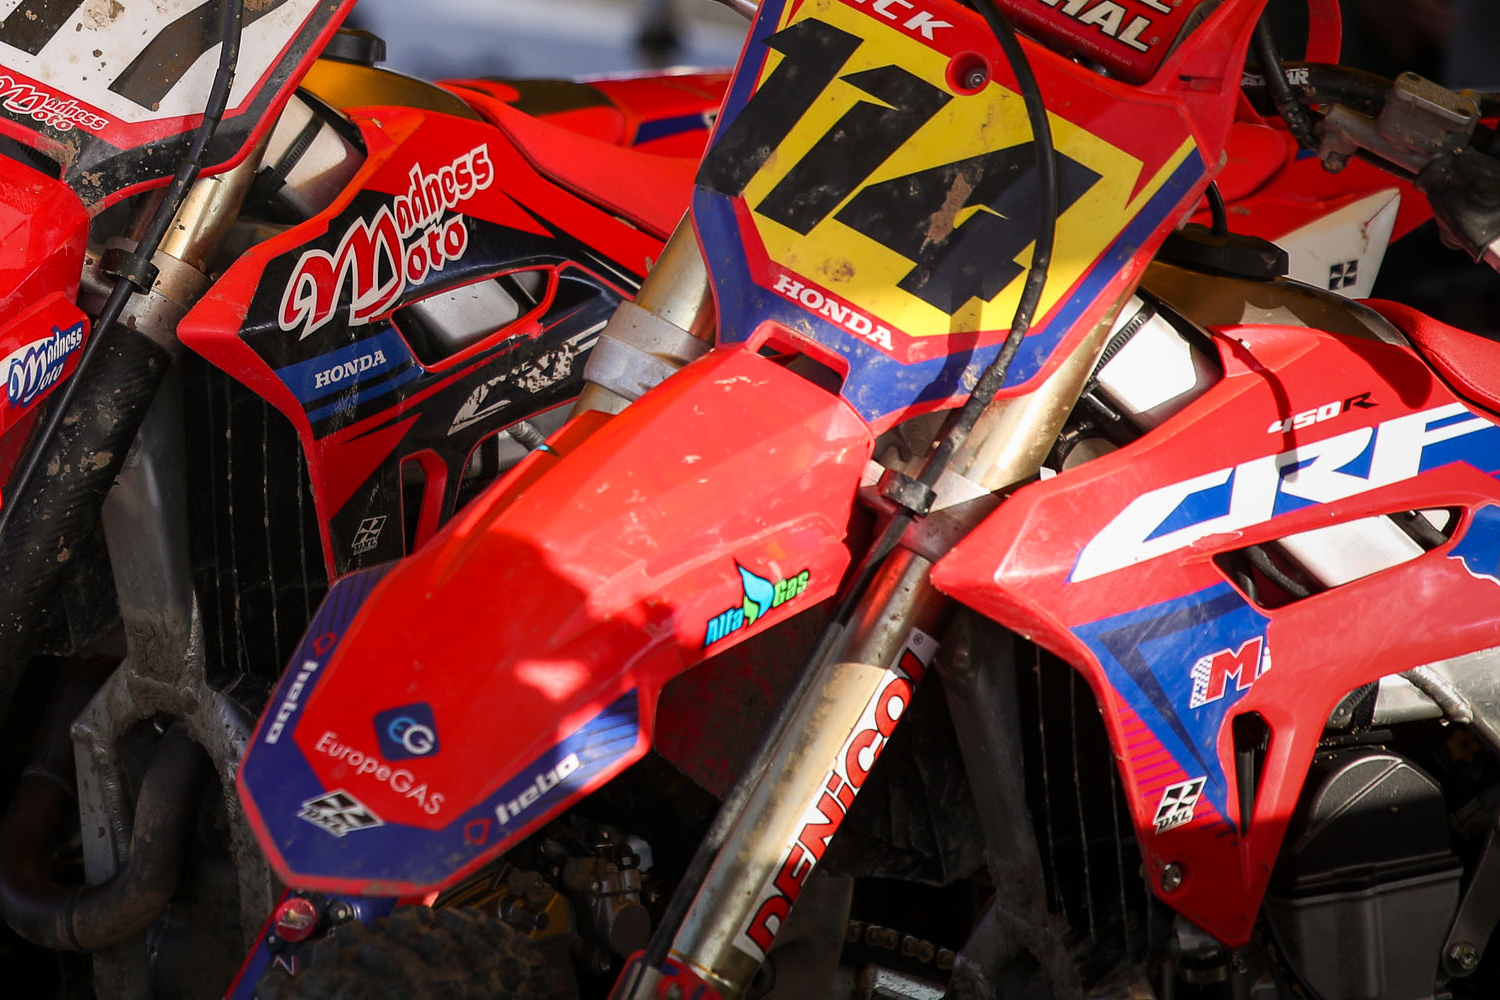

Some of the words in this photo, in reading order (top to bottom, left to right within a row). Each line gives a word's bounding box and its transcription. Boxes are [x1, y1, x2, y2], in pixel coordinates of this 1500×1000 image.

[695, 17, 1104, 317] 114
[772, 272, 895, 351] HONDA
[314, 350, 387, 389] HONDA
[1267, 390, 1380, 435] 450R
[1070, 401, 1500, 584] CRF
[703, 606, 745, 648] Alfa
[314, 730, 445, 815] EuropeGAS
[494, 752, 580, 826] hebo
[1157, 811, 1193, 832] DXL
